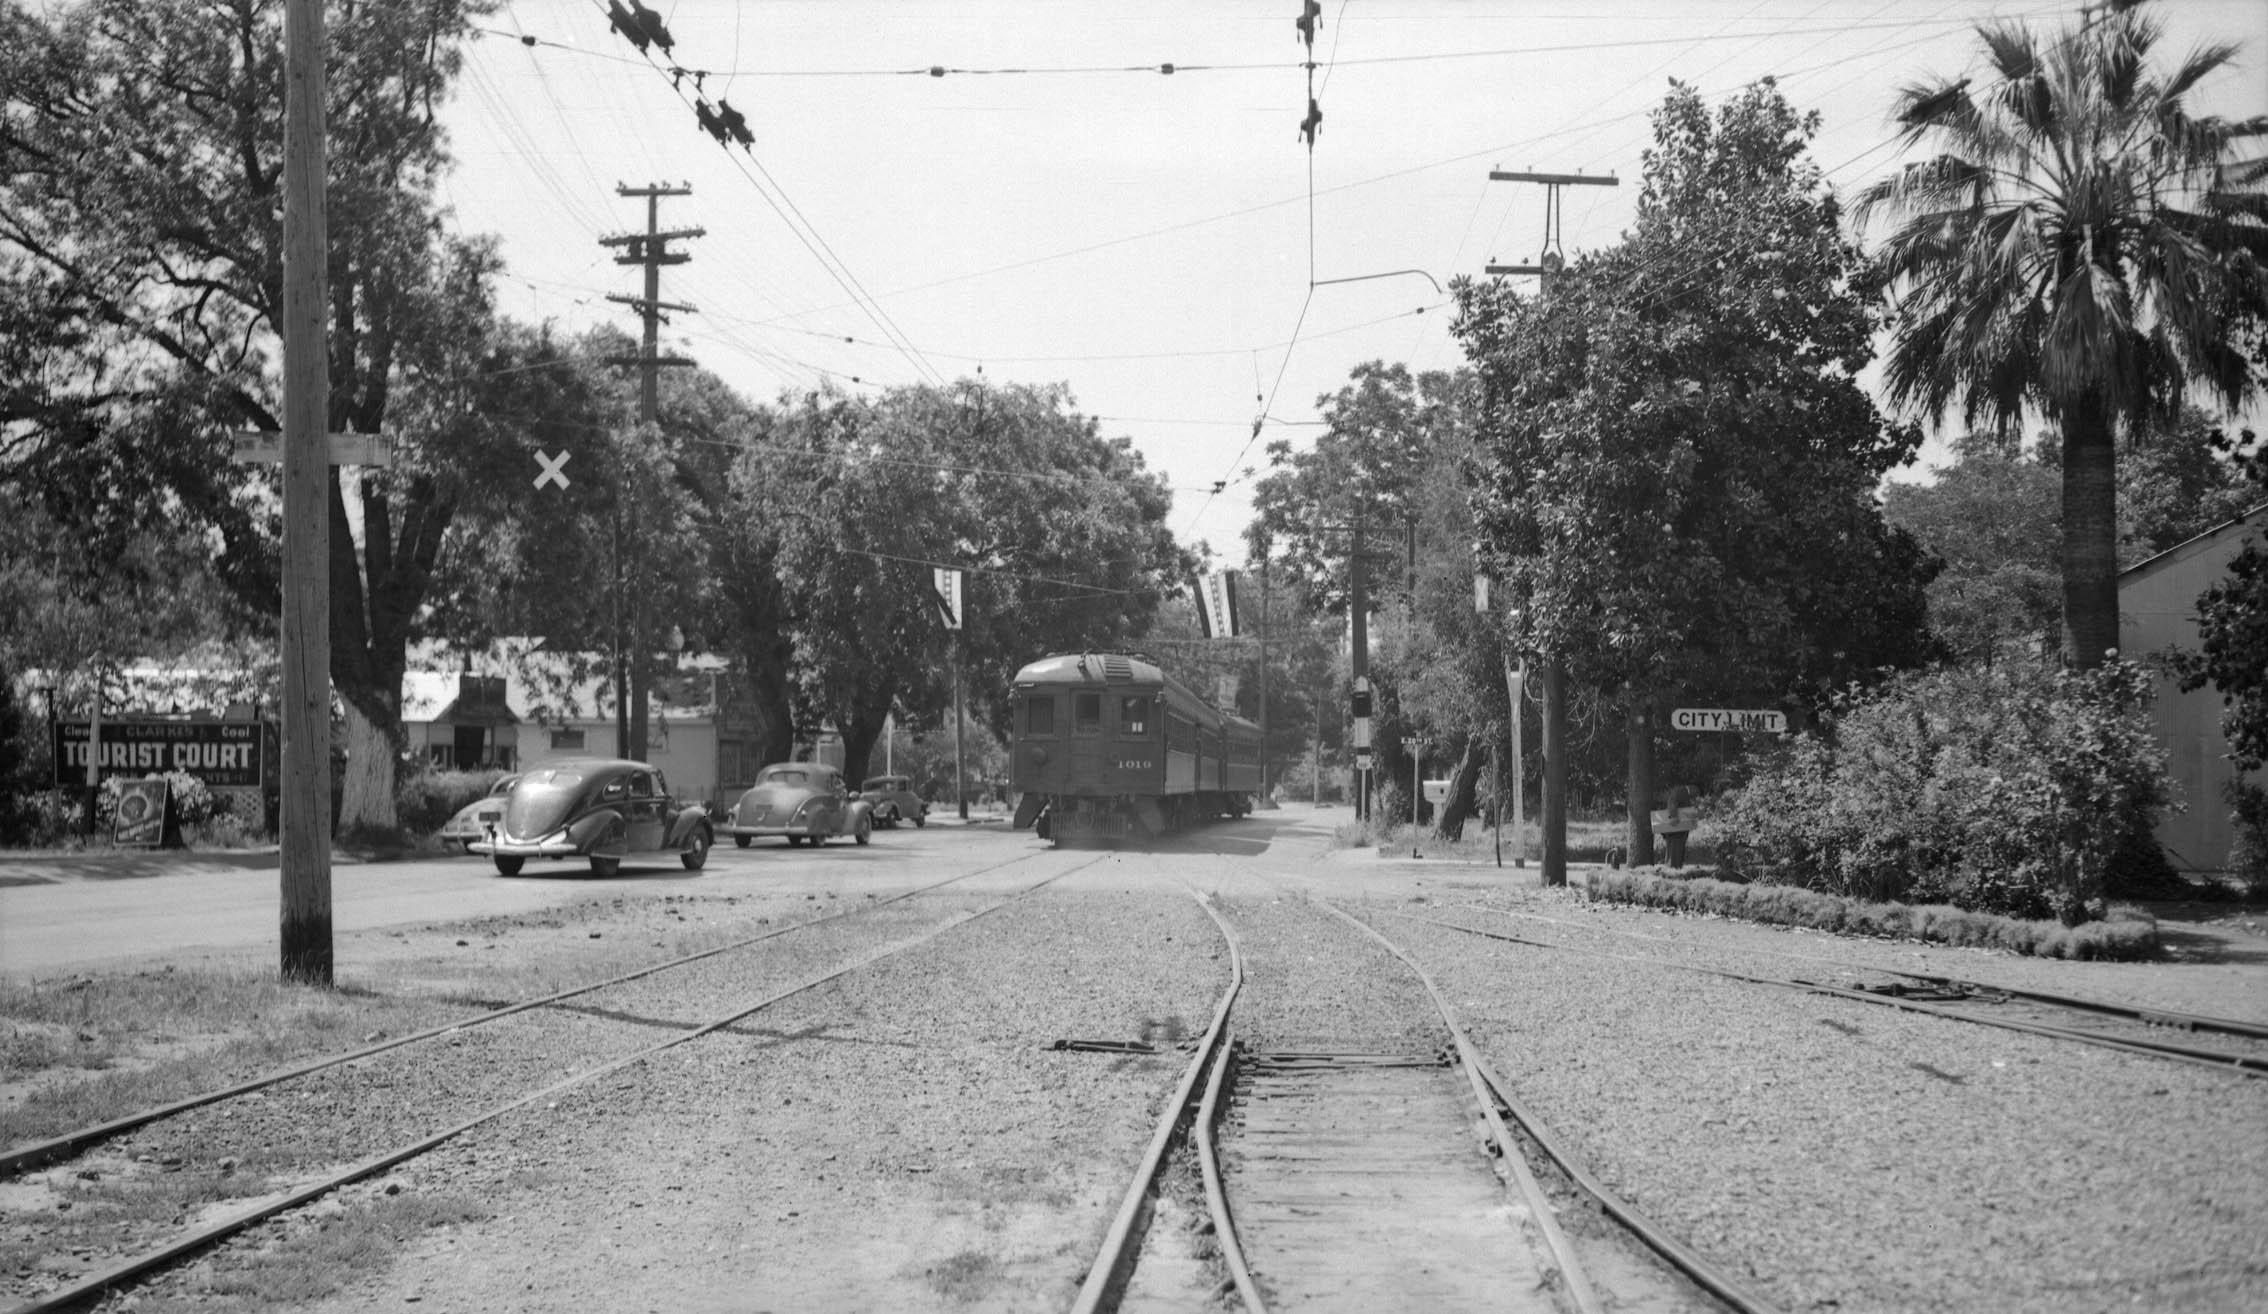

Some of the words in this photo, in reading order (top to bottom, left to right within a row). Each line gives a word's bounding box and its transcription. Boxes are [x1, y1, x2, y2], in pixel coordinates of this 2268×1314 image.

[1678, 712, 1722, 728] CITY
[1727, 712, 1778, 729] LIMIT
[63, 741, 167, 768] TOURIST
[172, 742, 254, 769] COURT
